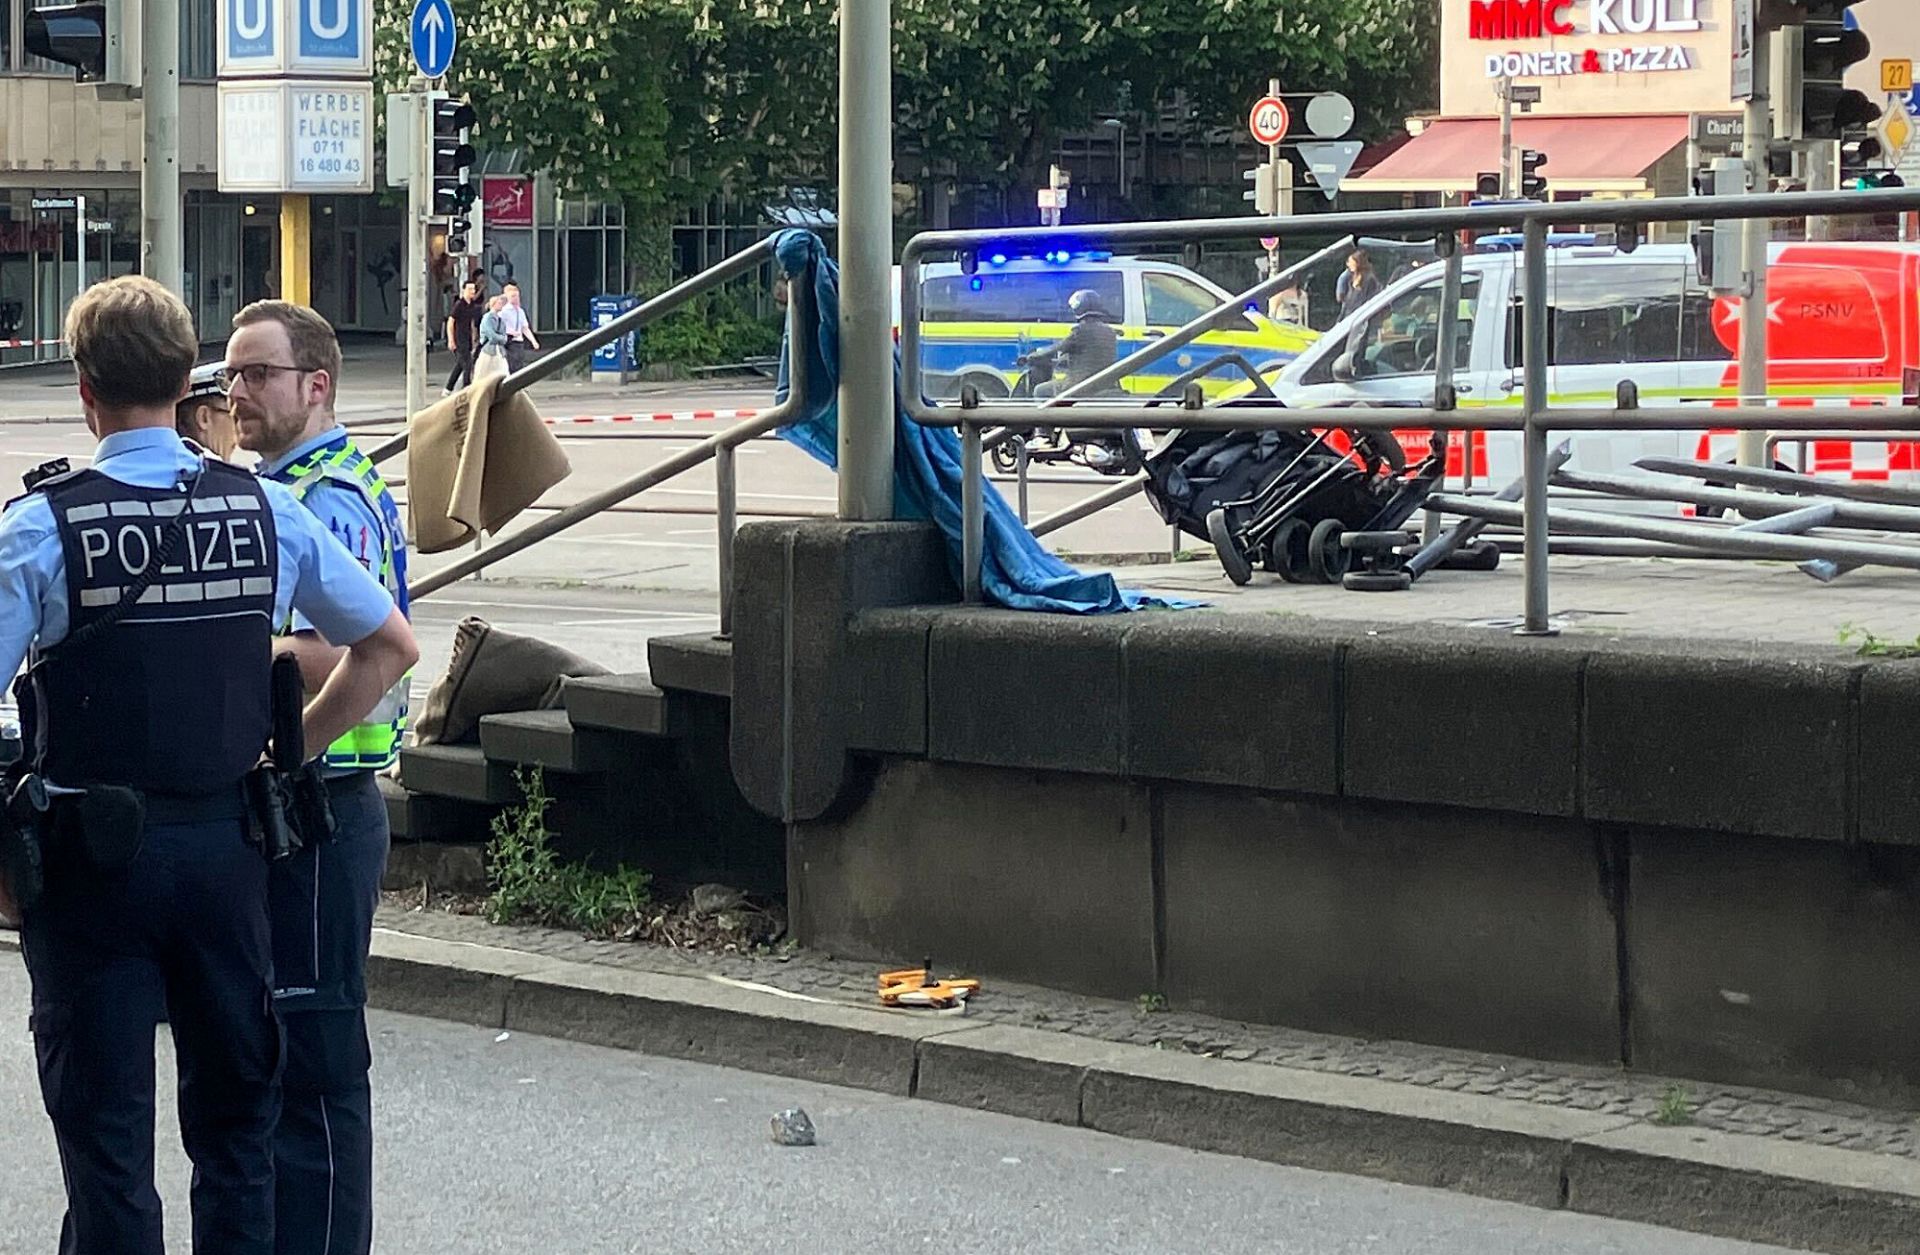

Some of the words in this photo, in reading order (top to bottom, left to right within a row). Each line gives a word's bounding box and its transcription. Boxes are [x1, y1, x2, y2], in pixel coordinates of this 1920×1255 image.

[309, 0, 349, 40] U
[1470, 0, 1574, 39] MMC
[1581, 49, 1601, 72] &
[1888, 65, 1903, 86] 27
[299, 94, 360, 111] WERBE
[299, 117, 360, 137] FLÄCHE
[1259, 111, 1280, 130] 40
[1707, 119, 1743, 134] Charlo
[300, 158, 314, 172] 16
[318, 158, 341, 172] 480
[345, 158, 360, 172] 43
[1800, 303, 1854, 319] PSNV
[80, 518, 268, 579] POLIZEI
